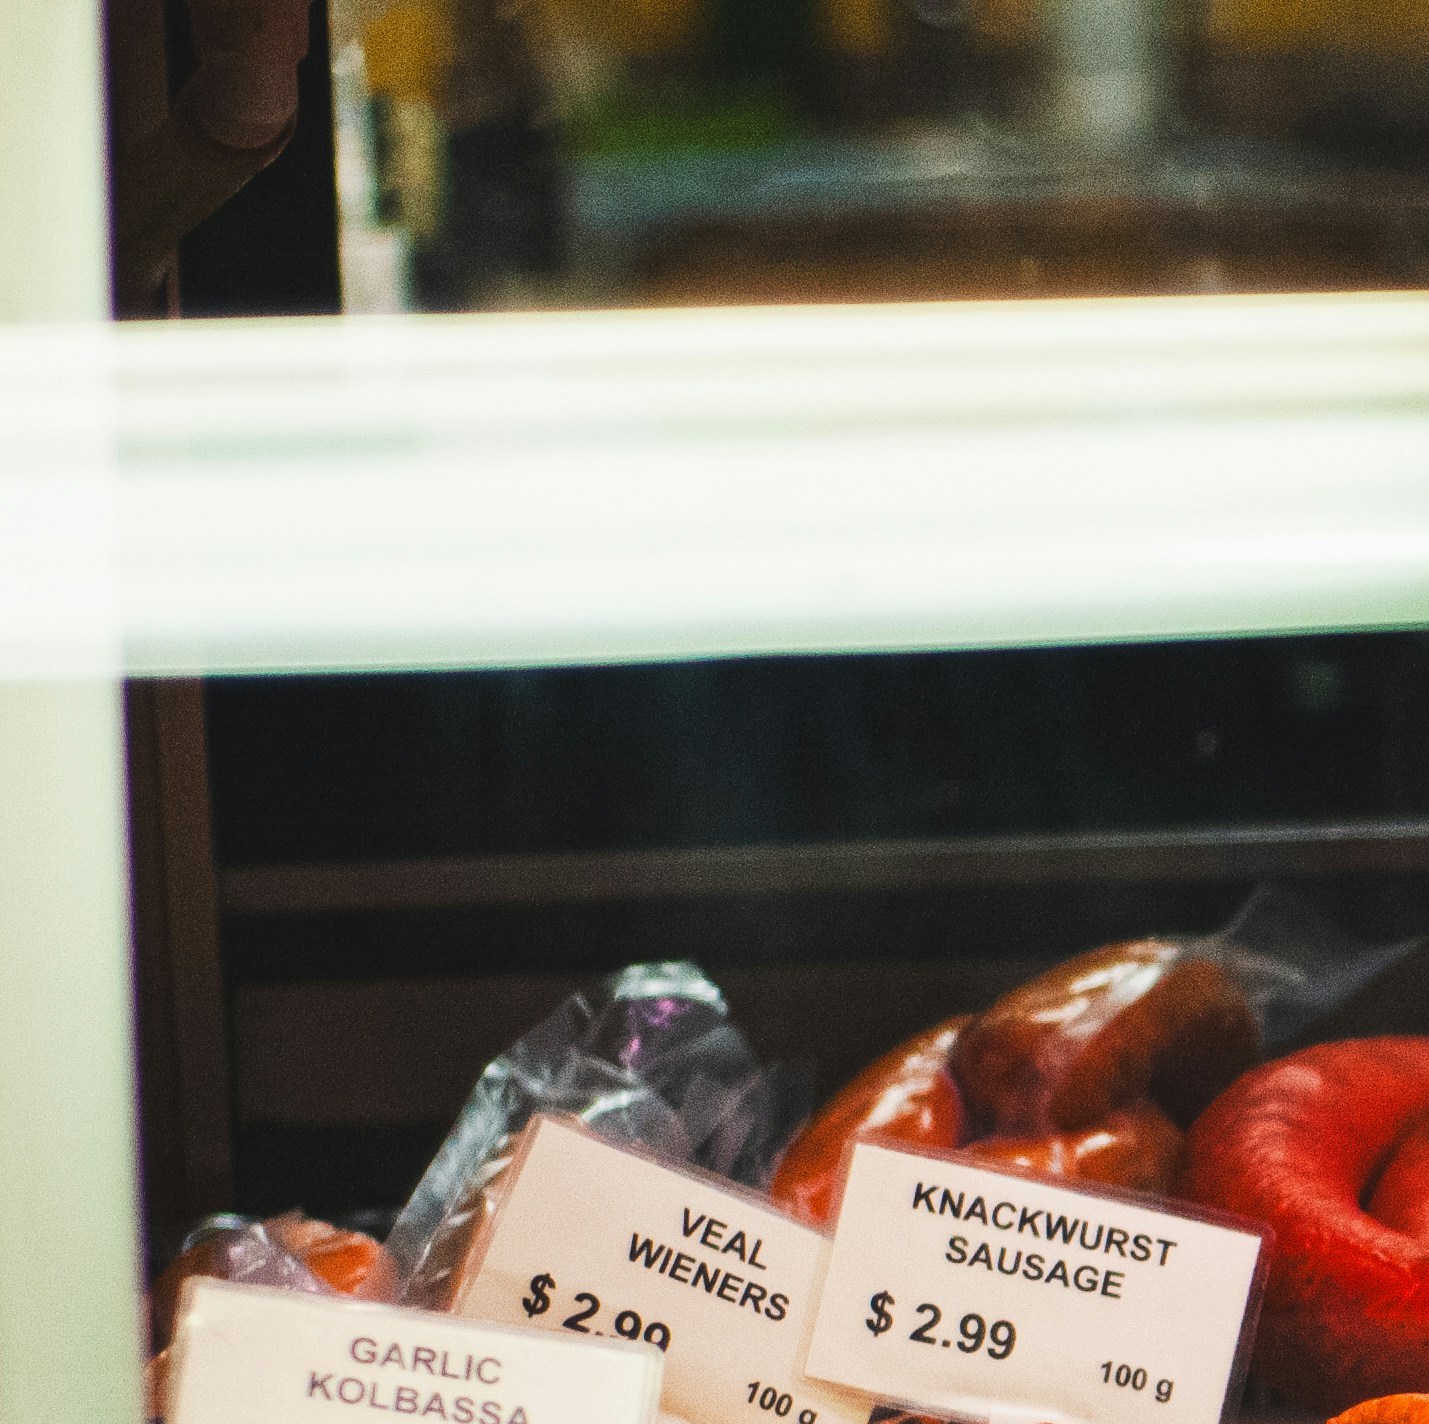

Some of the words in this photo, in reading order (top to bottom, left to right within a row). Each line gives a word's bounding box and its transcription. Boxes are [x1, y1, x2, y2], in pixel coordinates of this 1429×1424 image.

[681, 1207, 767, 1271] VEAL
[911, 1182, 1178, 1267] KNACKWURST
[945, 1235, 1126, 1299] SAUSAGE
[628, 1232, 790, 1322] WIENERS
[349, 1336, 503, 1386] GARLIC
[522, 1273, 557, 1319] $
[747, 1381, 793, 1418] 100
[865, 1290, 896, 1338] $
[909, 1302, 1018, 1361] 2.99
[1099, 1360, 1148, 1393] 100
[1156, 1377, 1175, 1404] g
